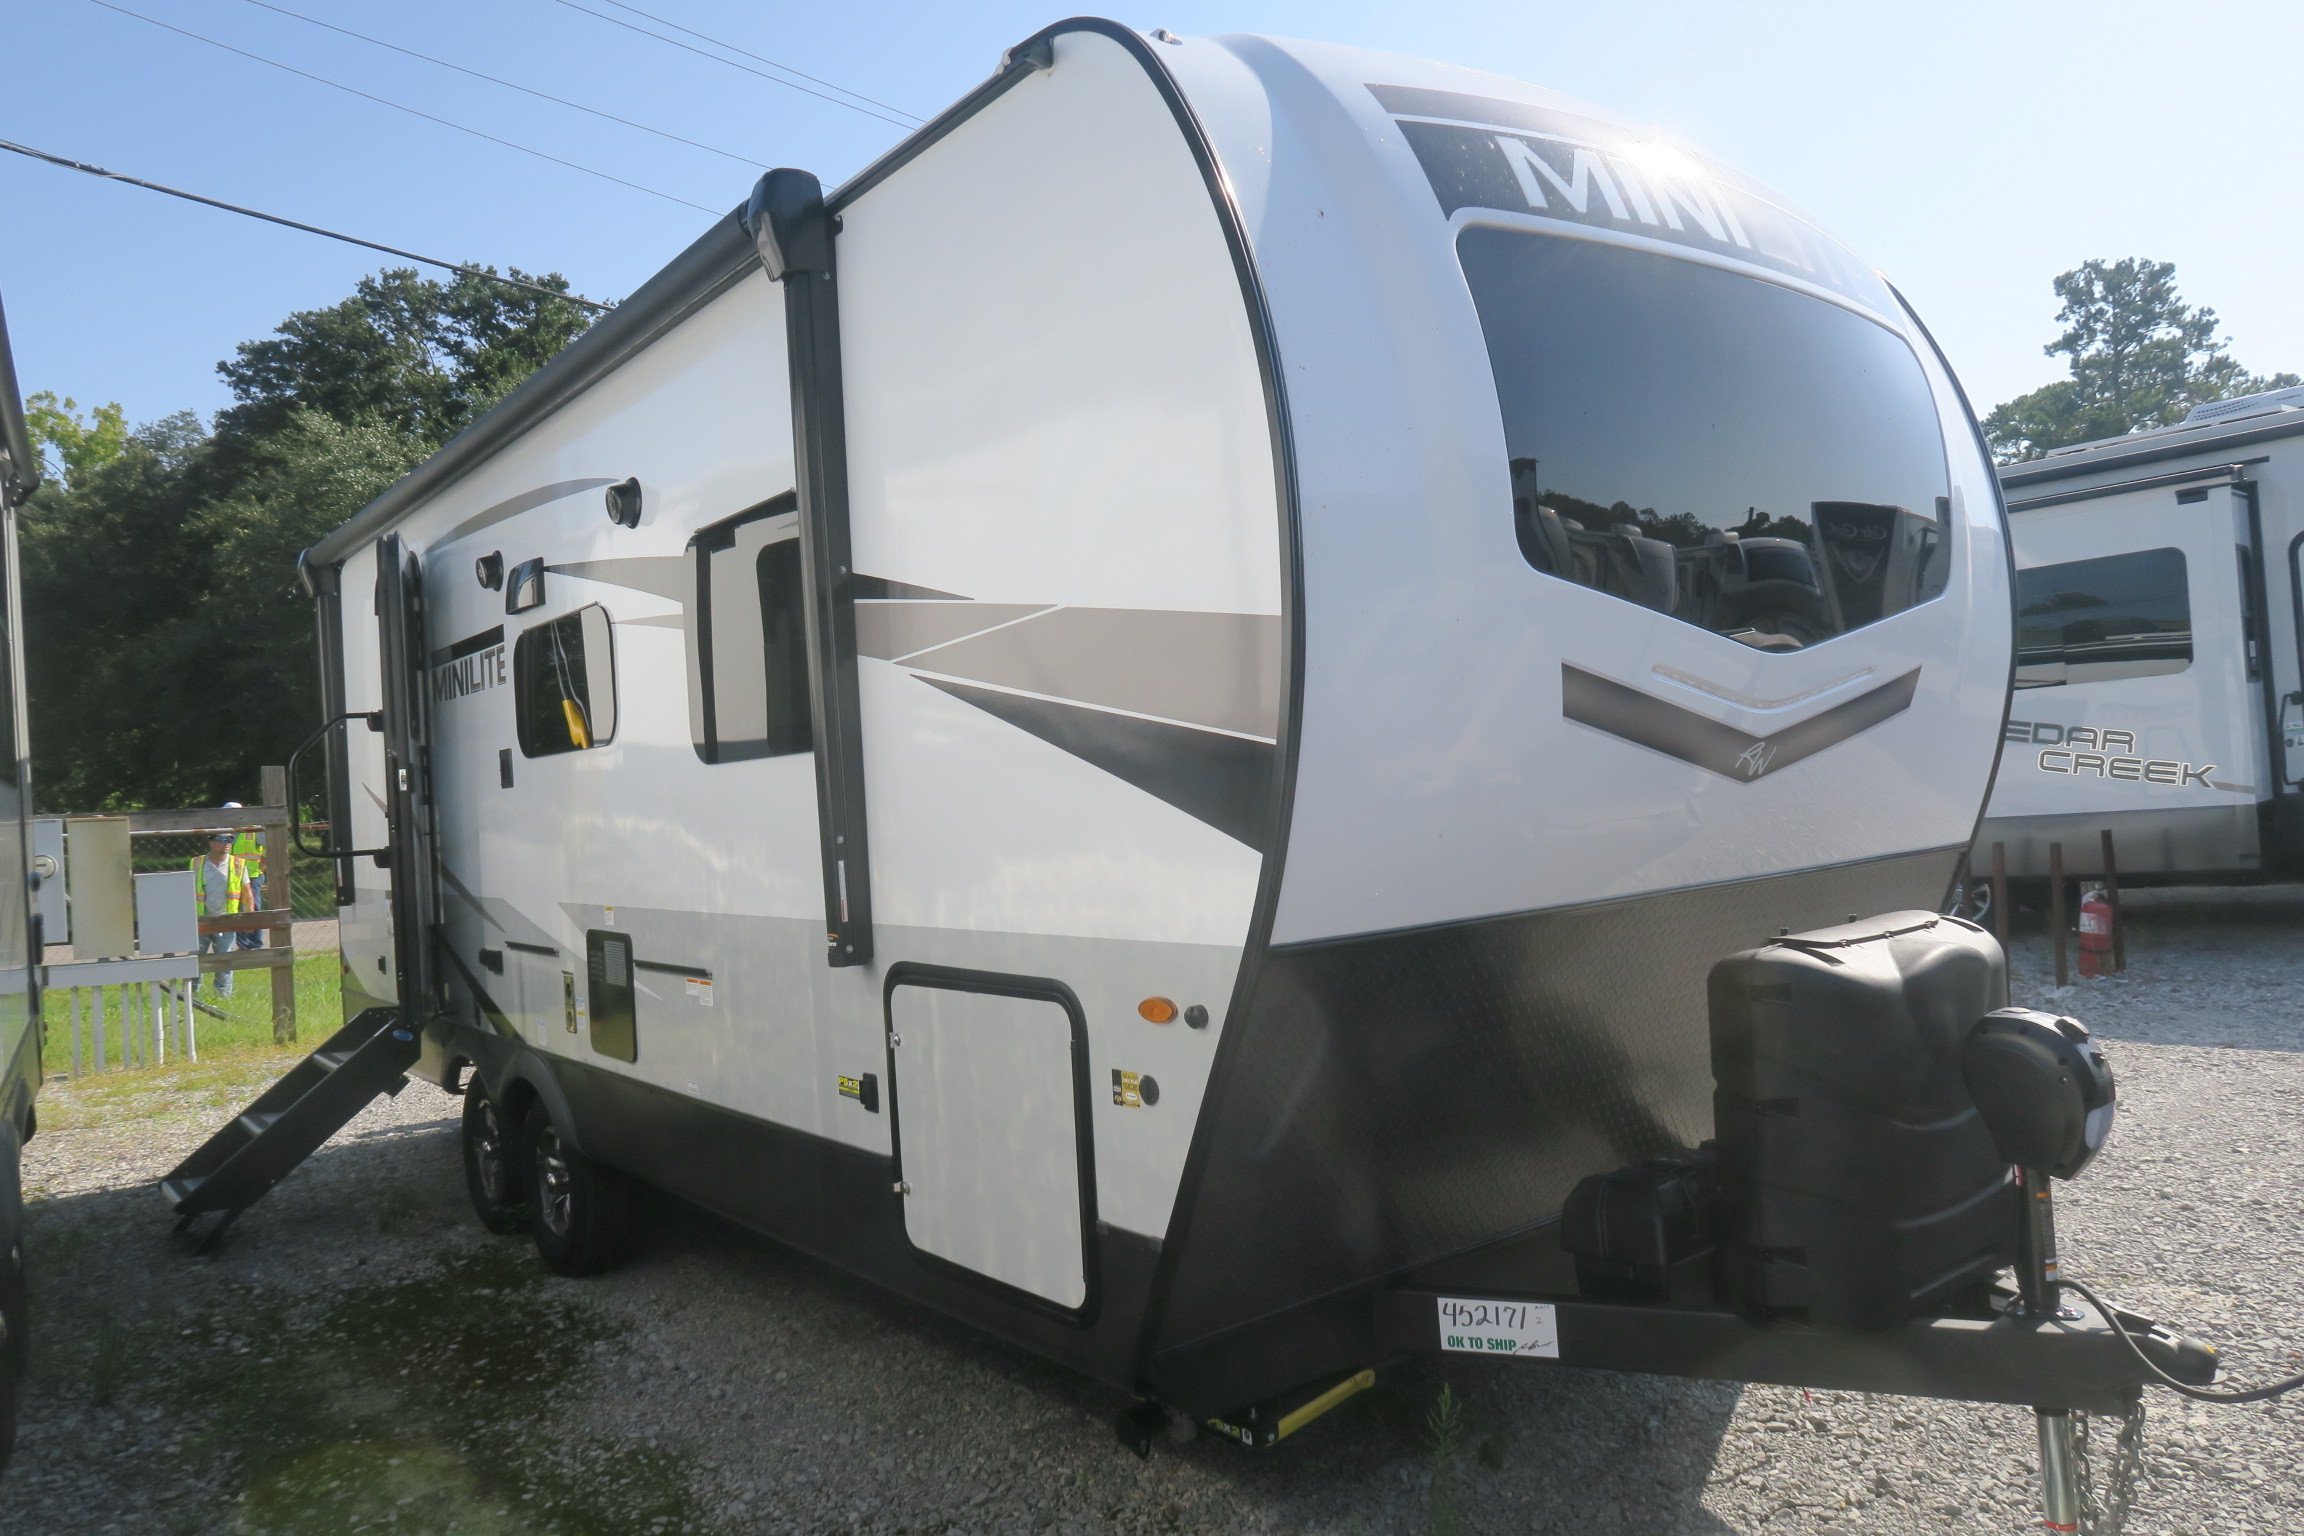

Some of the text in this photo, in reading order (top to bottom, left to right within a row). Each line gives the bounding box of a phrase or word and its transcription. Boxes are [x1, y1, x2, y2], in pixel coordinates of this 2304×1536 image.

[432, 645, 507, 705] MINILITE
[2037, 748, 2218, 788] CREEK
[1442, 1302, 1527, 1330] 452171
[1447, 1334, 1465, 1349] OK
[1468, 1335, 1484, 1350] TO
[1487, 1337, 1517, 1352] SHIP
